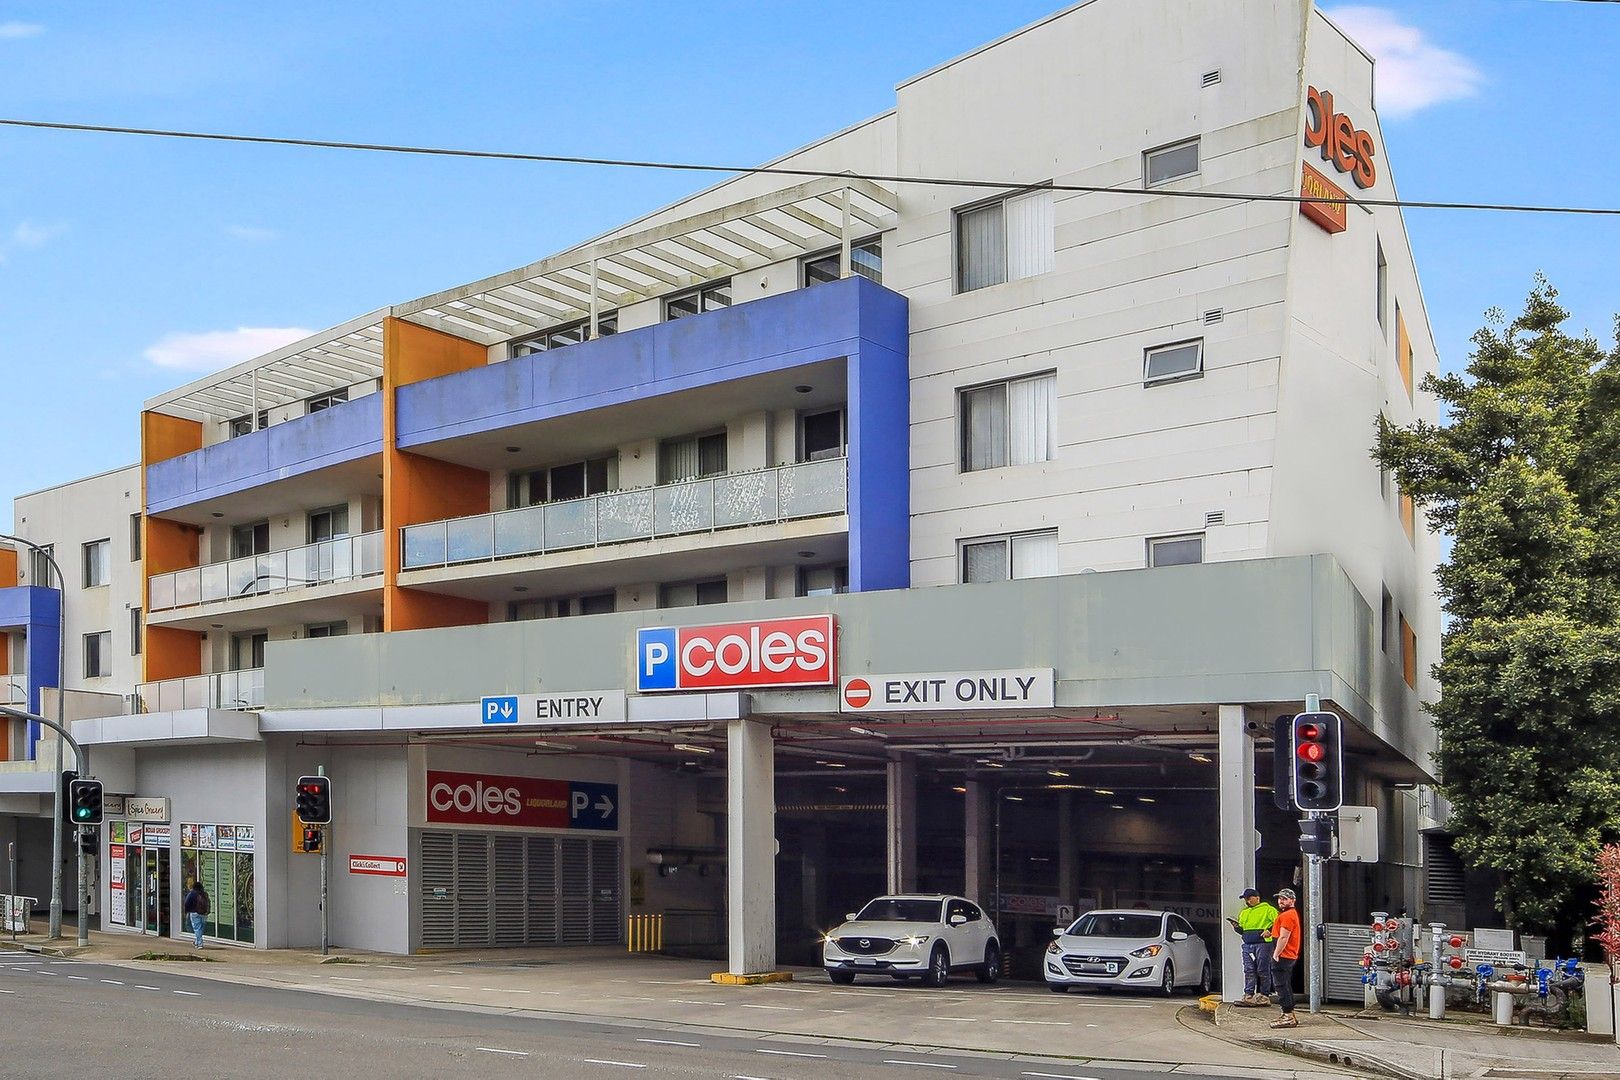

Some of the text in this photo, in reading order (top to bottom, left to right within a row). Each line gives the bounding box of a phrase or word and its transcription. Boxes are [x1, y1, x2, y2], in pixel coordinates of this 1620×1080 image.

[1305, 86, 1376, 189] oles
[646, 626, 827, 677] P coles
[885, 677, 1036, 704] EXIT ONLY
[487, 697, 604, 719] P ENTRY
[430, 780, 522, 816] coles
[572, 791, 589, 818] P
[1195, 907, 1220, 918] ONL
[1109, 963, 1116, 971] P
